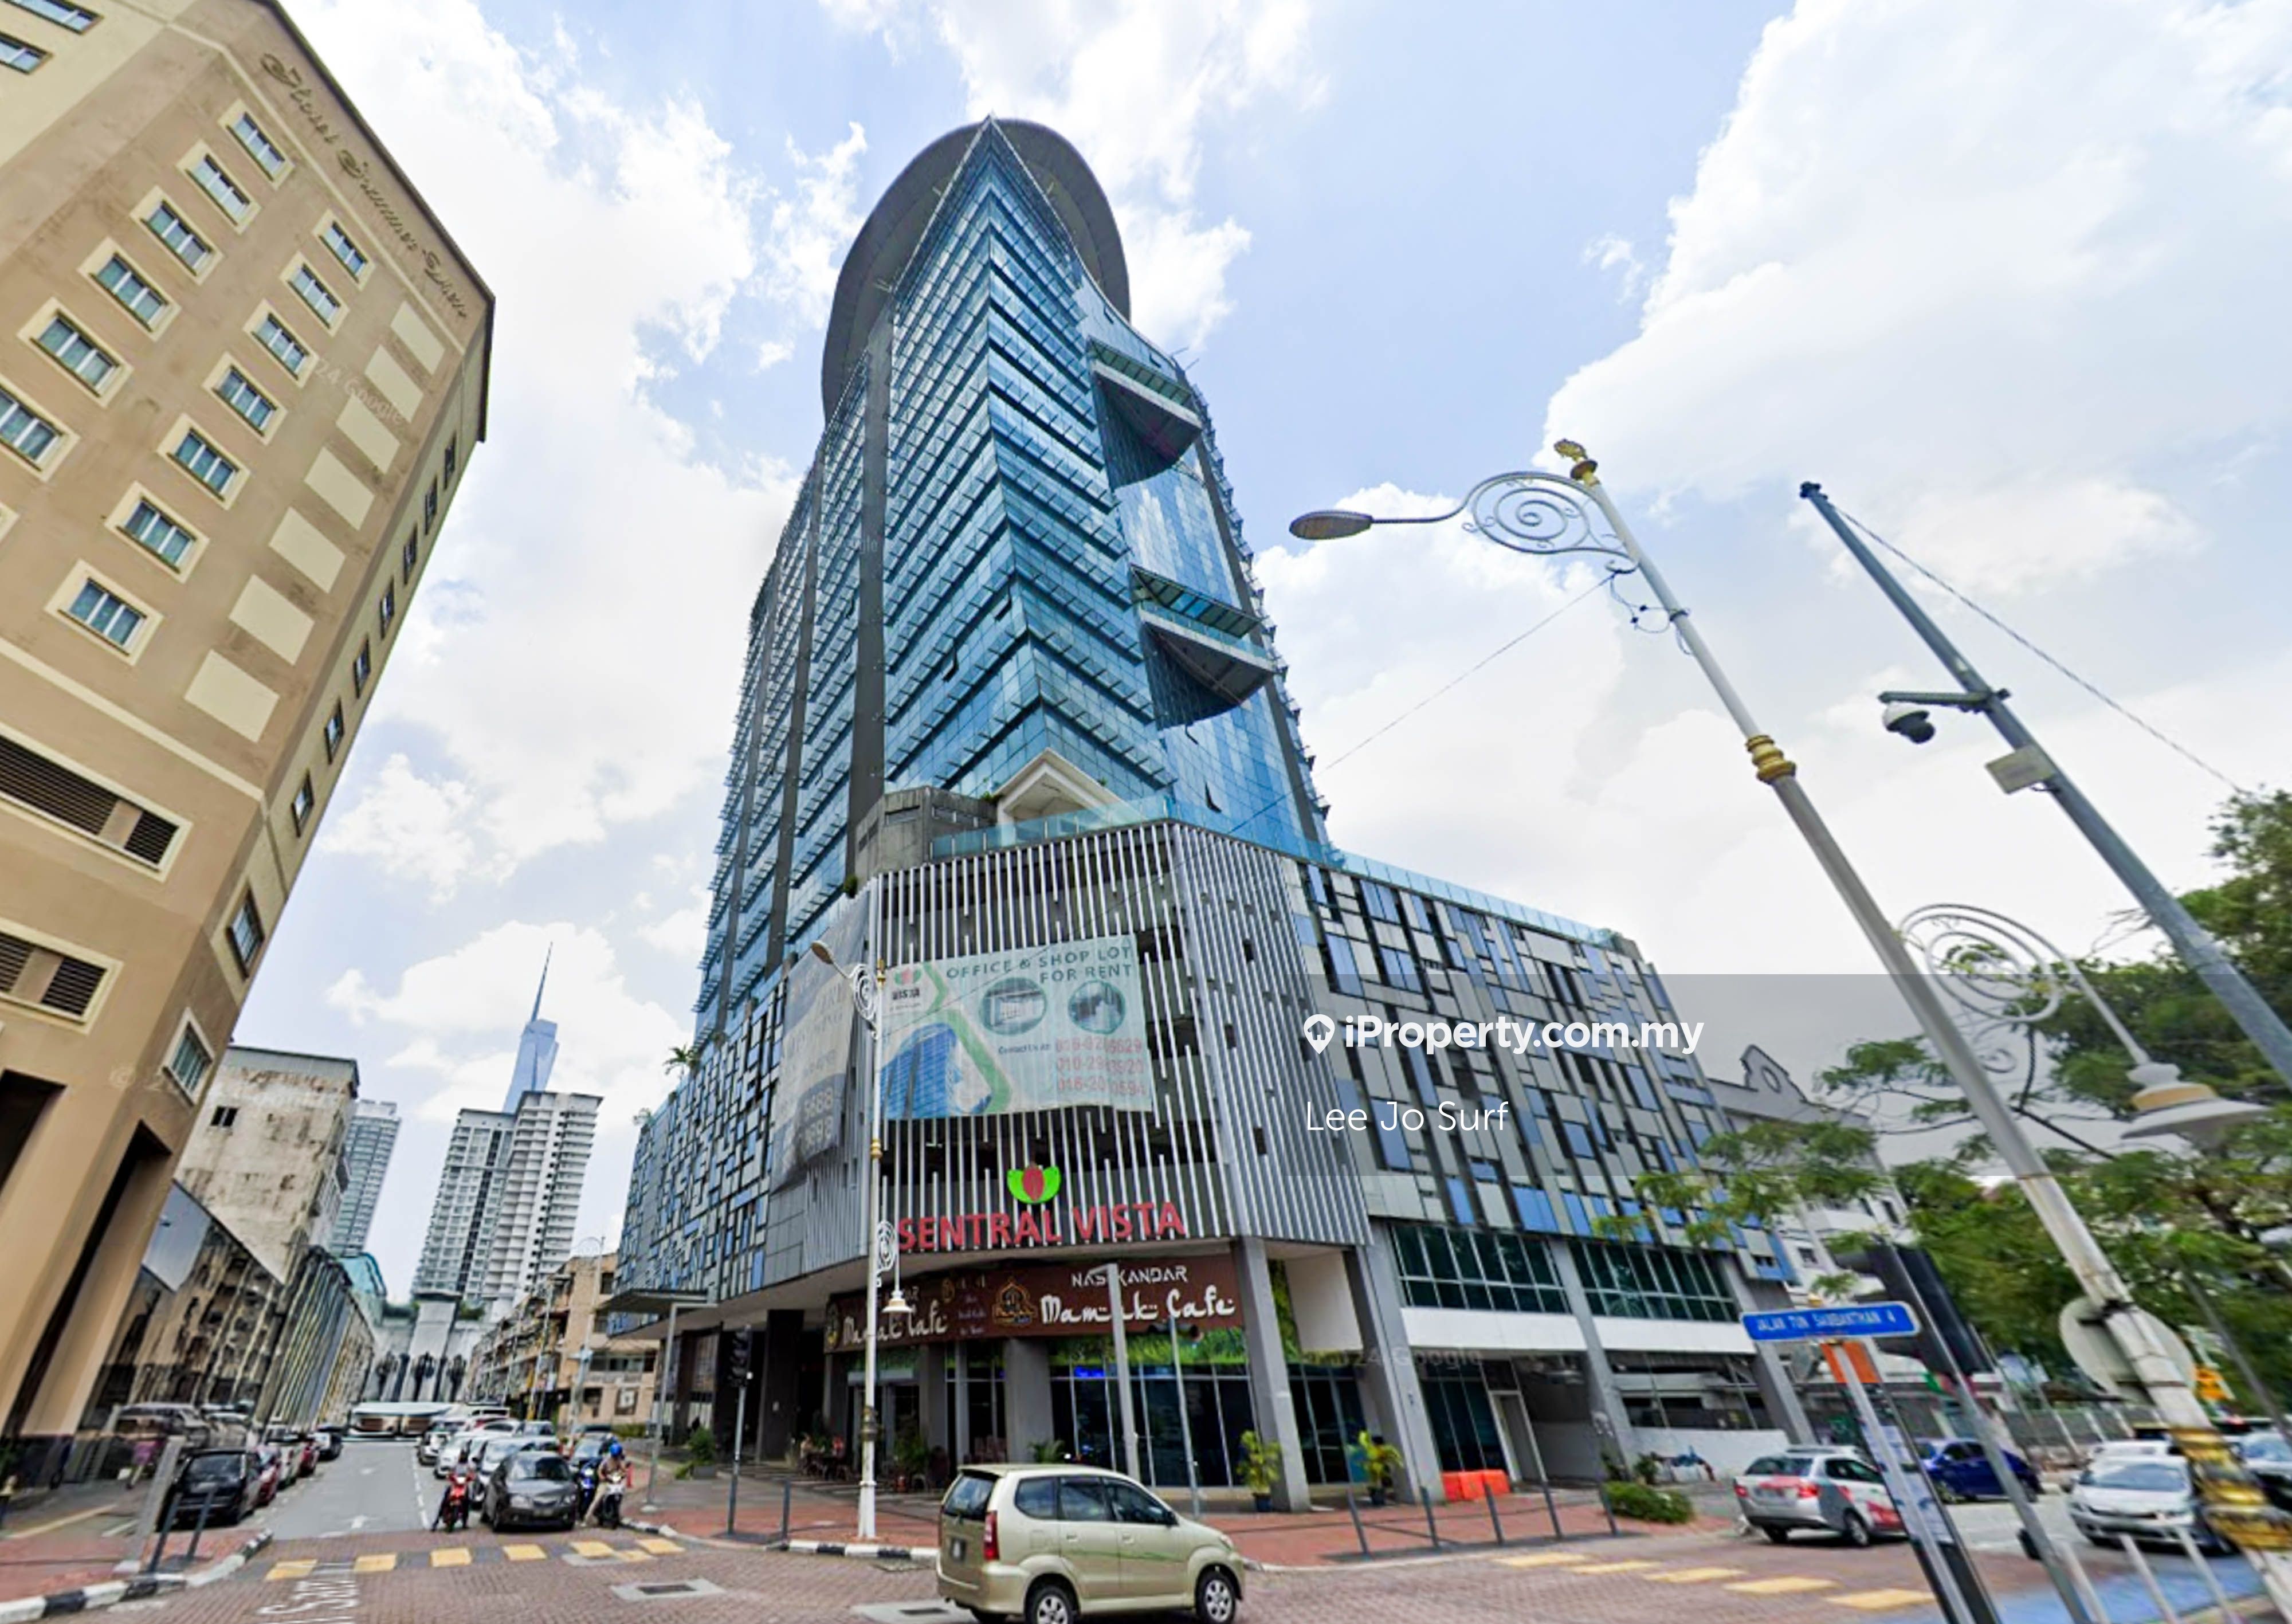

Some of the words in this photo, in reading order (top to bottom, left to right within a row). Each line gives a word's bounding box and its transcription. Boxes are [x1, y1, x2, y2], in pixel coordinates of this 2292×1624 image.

[946, 960, 1012, 979] OFFICE
[1019, 958, 1030, 968] &
[1039, 951, 1090, 968] SHOP
[1098, 946, 1132, 960] LOT
[1040, 968, 1077, 984] FOR
[1085, 964, 1133, 978] RENT
[898, 1210, 1062, 1250] SENTRAL
[1072, 1202, 1186, 1239] VISTA
[1071, 1272, 1109, 1287] NAS
